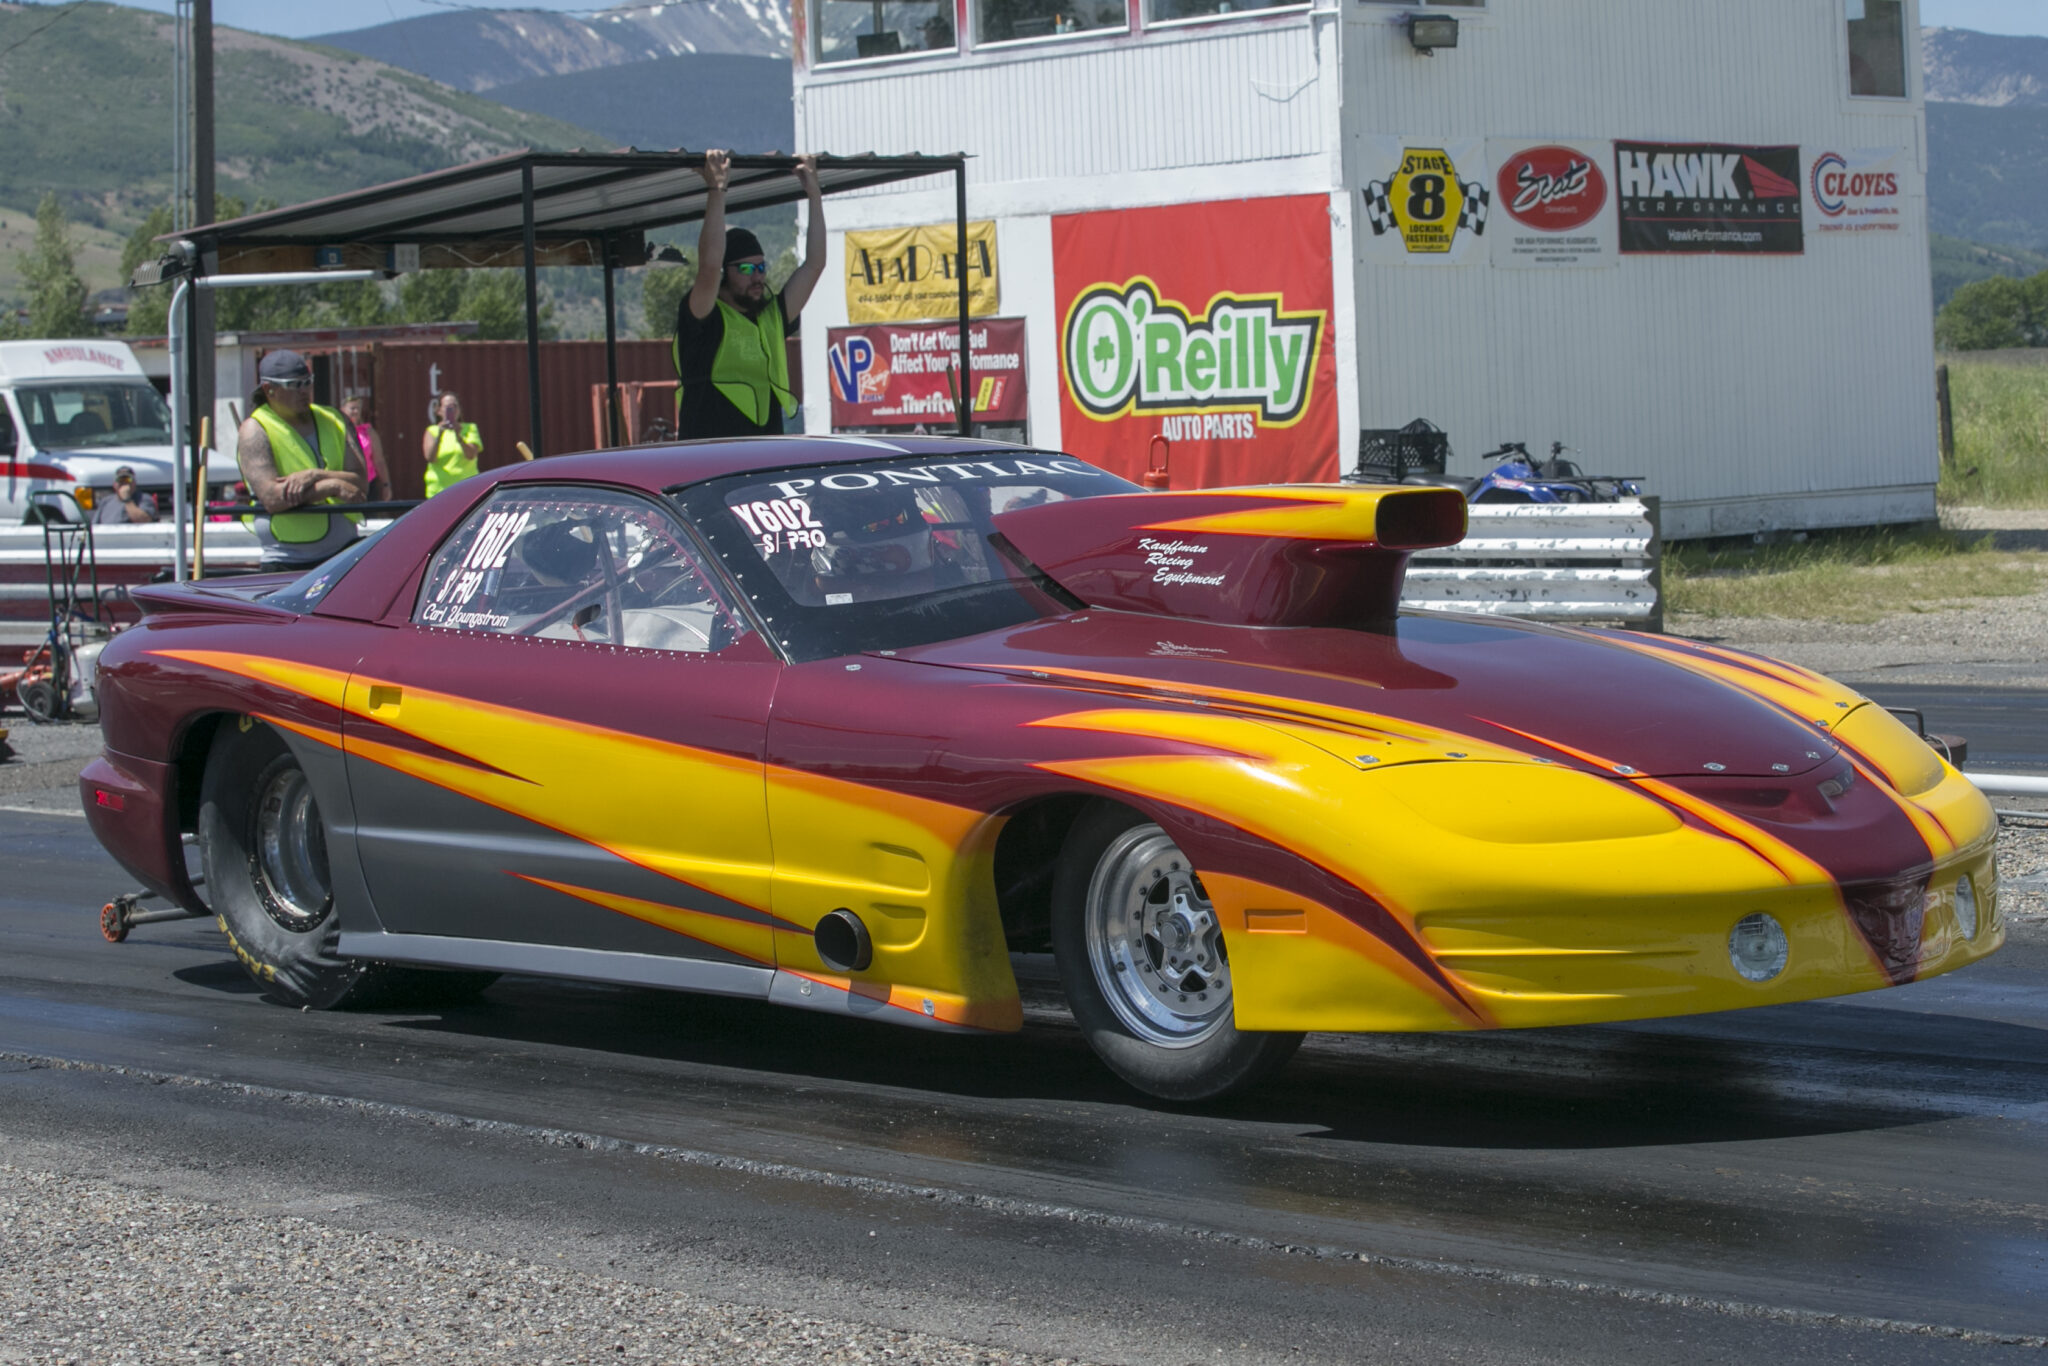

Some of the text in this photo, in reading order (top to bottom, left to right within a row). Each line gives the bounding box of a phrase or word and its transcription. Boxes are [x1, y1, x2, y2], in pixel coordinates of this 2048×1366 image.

[1402, 155, 1452, 176] STAGE
[1618, 150, 1745, 200] HAWK
[1407, 174, 1446, 220] 8
[1823, 172, 1898, 197] CLOYES
[1623, 200, 1800, 214] PERFORMANCE
[1406, 234, 1450, 243] FASTENERS
[1409, 224, 1444, 233] LOCKING
[1667, 229, 1762, 243] HawkPerformance.com
[890, 332, 919, 353] Don't
[919, 331, 940, 351] Let
[967, 328, 988, 349] uel
[1076, 297, 1304, 406] O'Reilly
[43, 346, 126, 372] AMBULANCE
[829, 336, 875, 404] VP
[890, 353, 924, 374] Affect
[924, 352, 950, 373] Your
[860, 369, 890, 394] Racing
[1162, 415, 1201, 441] AUTO
[769, 459, 1101, 499] PONTIAC
[730, 498, 823, 537] Y602
[461, 511, 530, 570] Y602
[1137, 538, 1208, 555] Kauffman
[1145, 552, 1194, 569] Racing
[1153, 567, 1226, 586] Equipment
[422, 603, 509, 627] Carl Youngstrom
